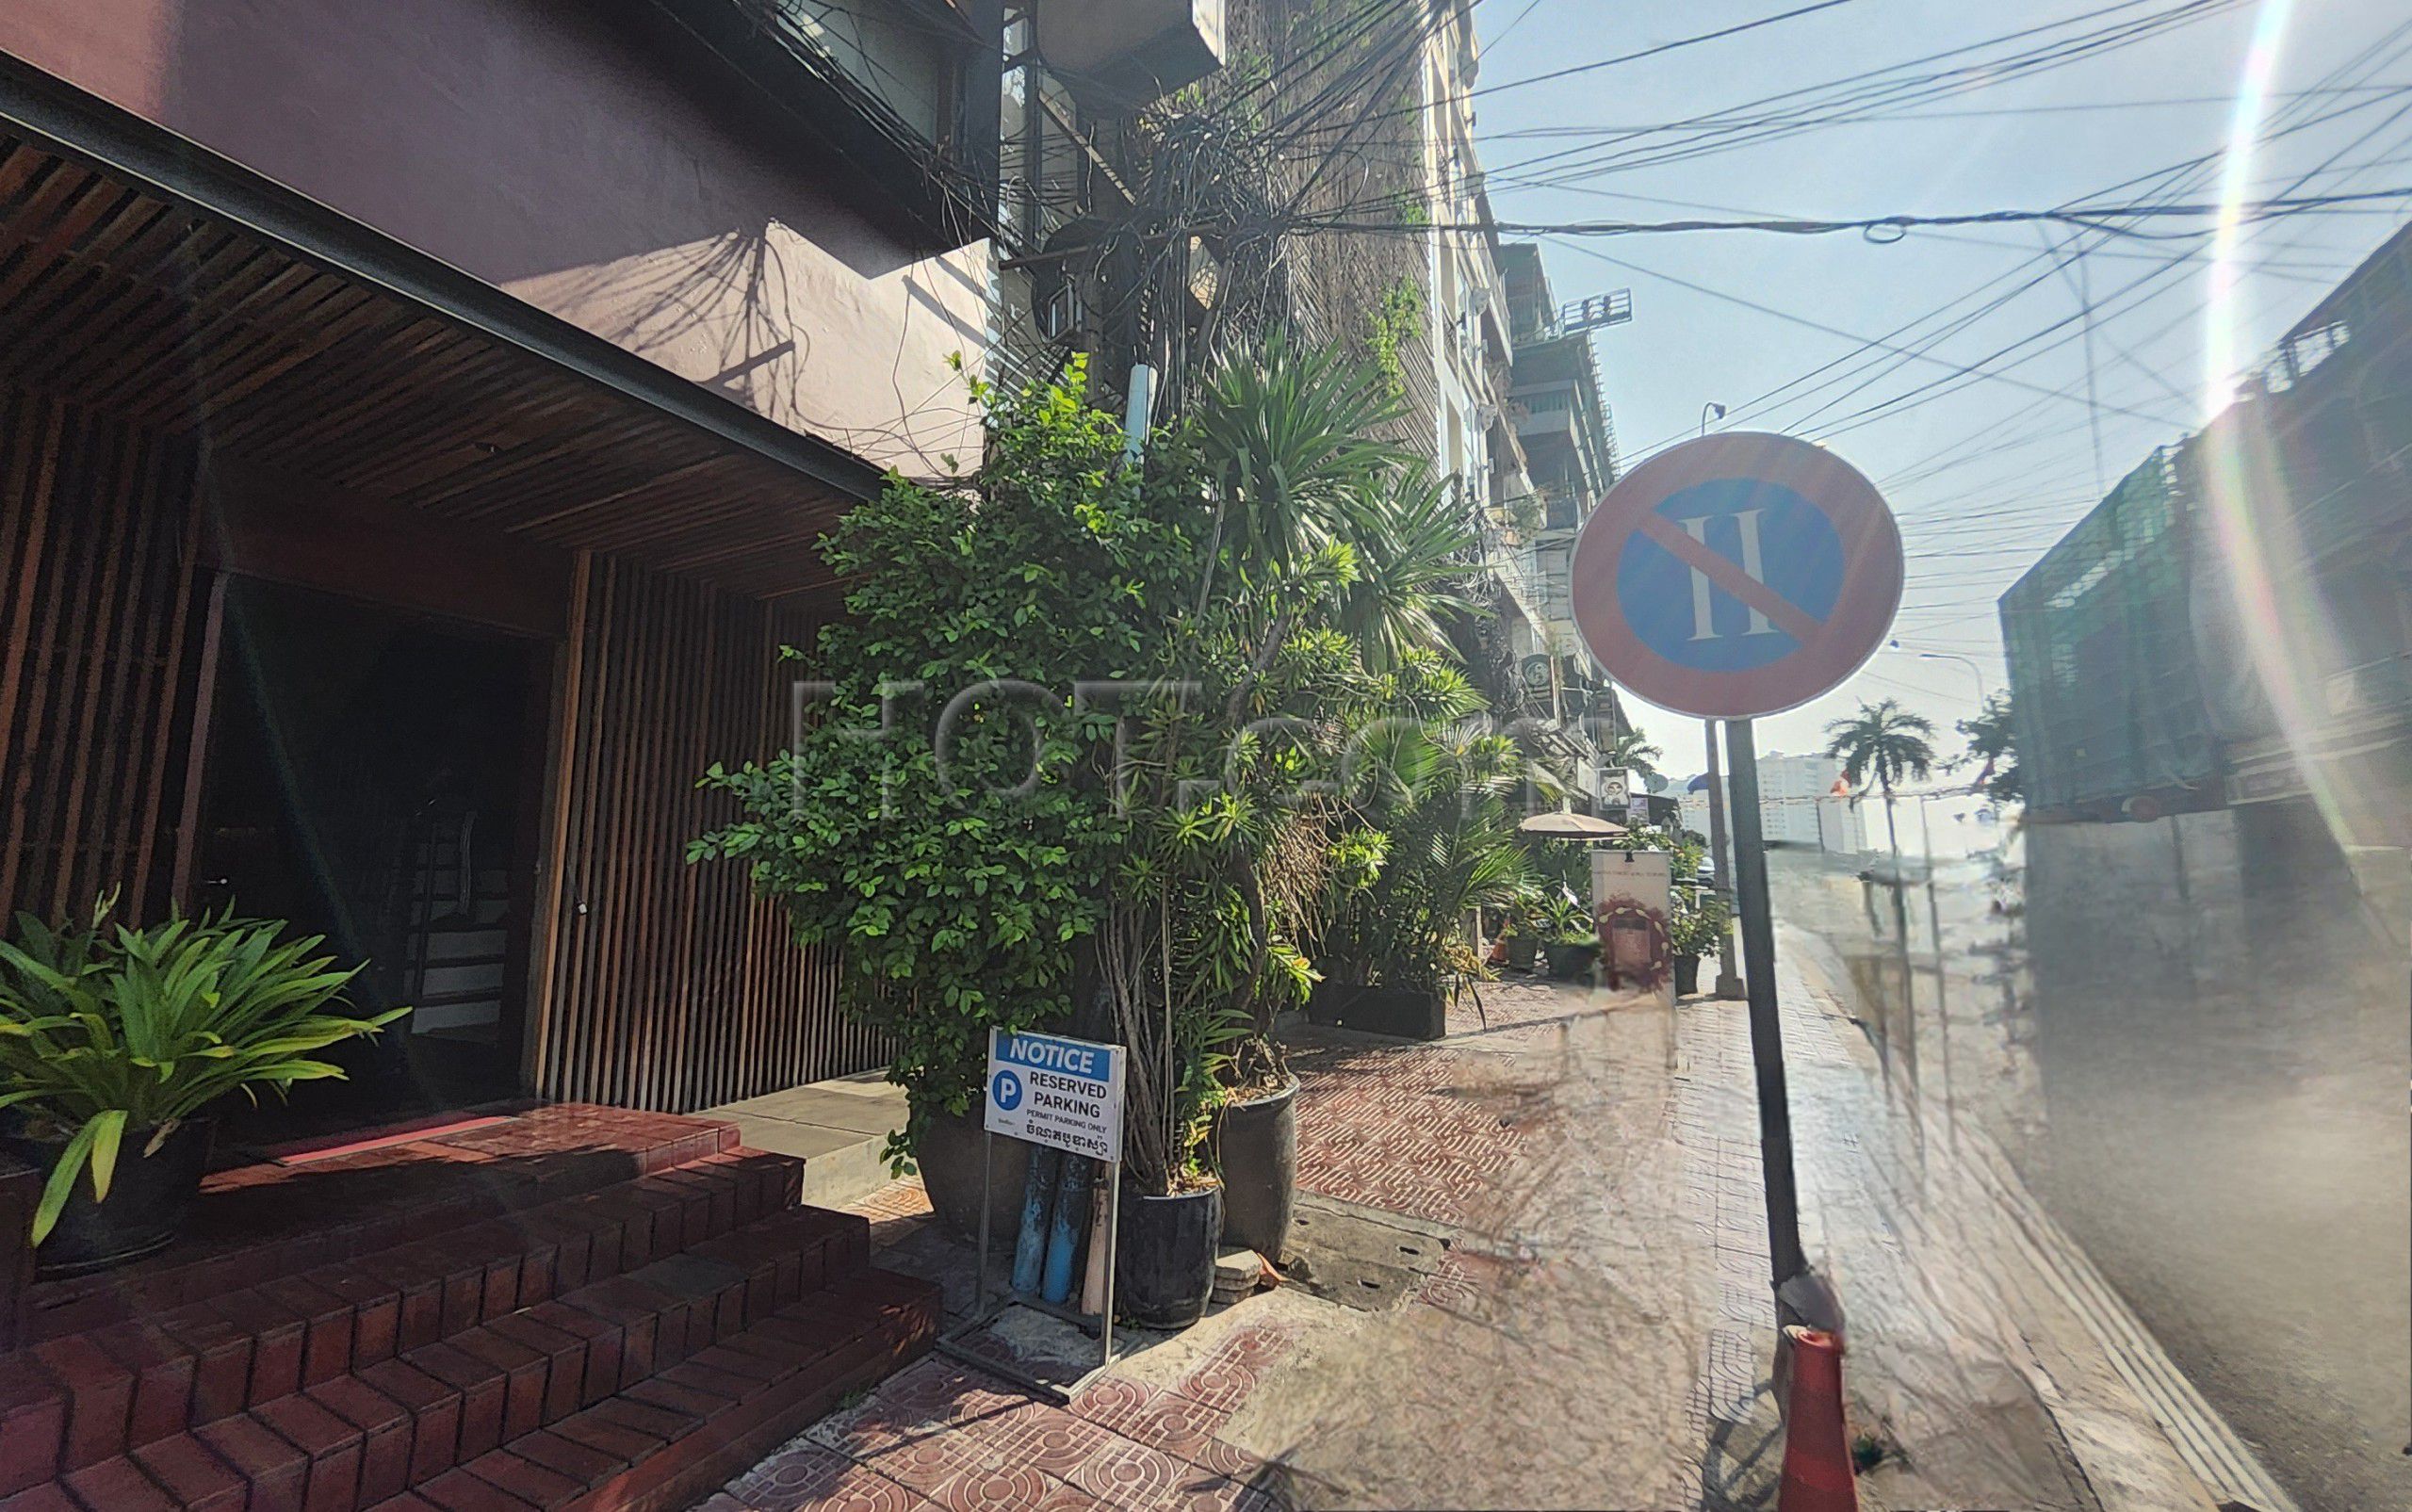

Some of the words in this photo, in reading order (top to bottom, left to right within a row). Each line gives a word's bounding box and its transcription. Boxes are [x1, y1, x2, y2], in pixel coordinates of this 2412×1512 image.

[1009, 1038, 1095, 1074] NOTICE
[1000, 1078, 1017, 1103] P
[1030, 1071, 1107, 1099] RESERVED
[1034, 1091, 1100, 1118] PARKING
[1026, 1109, 1053, 1122] PERMIT
[1054, 1116, 1086, 1130] PARKING
[1087, 1123, 1107, 1134] ONLY
